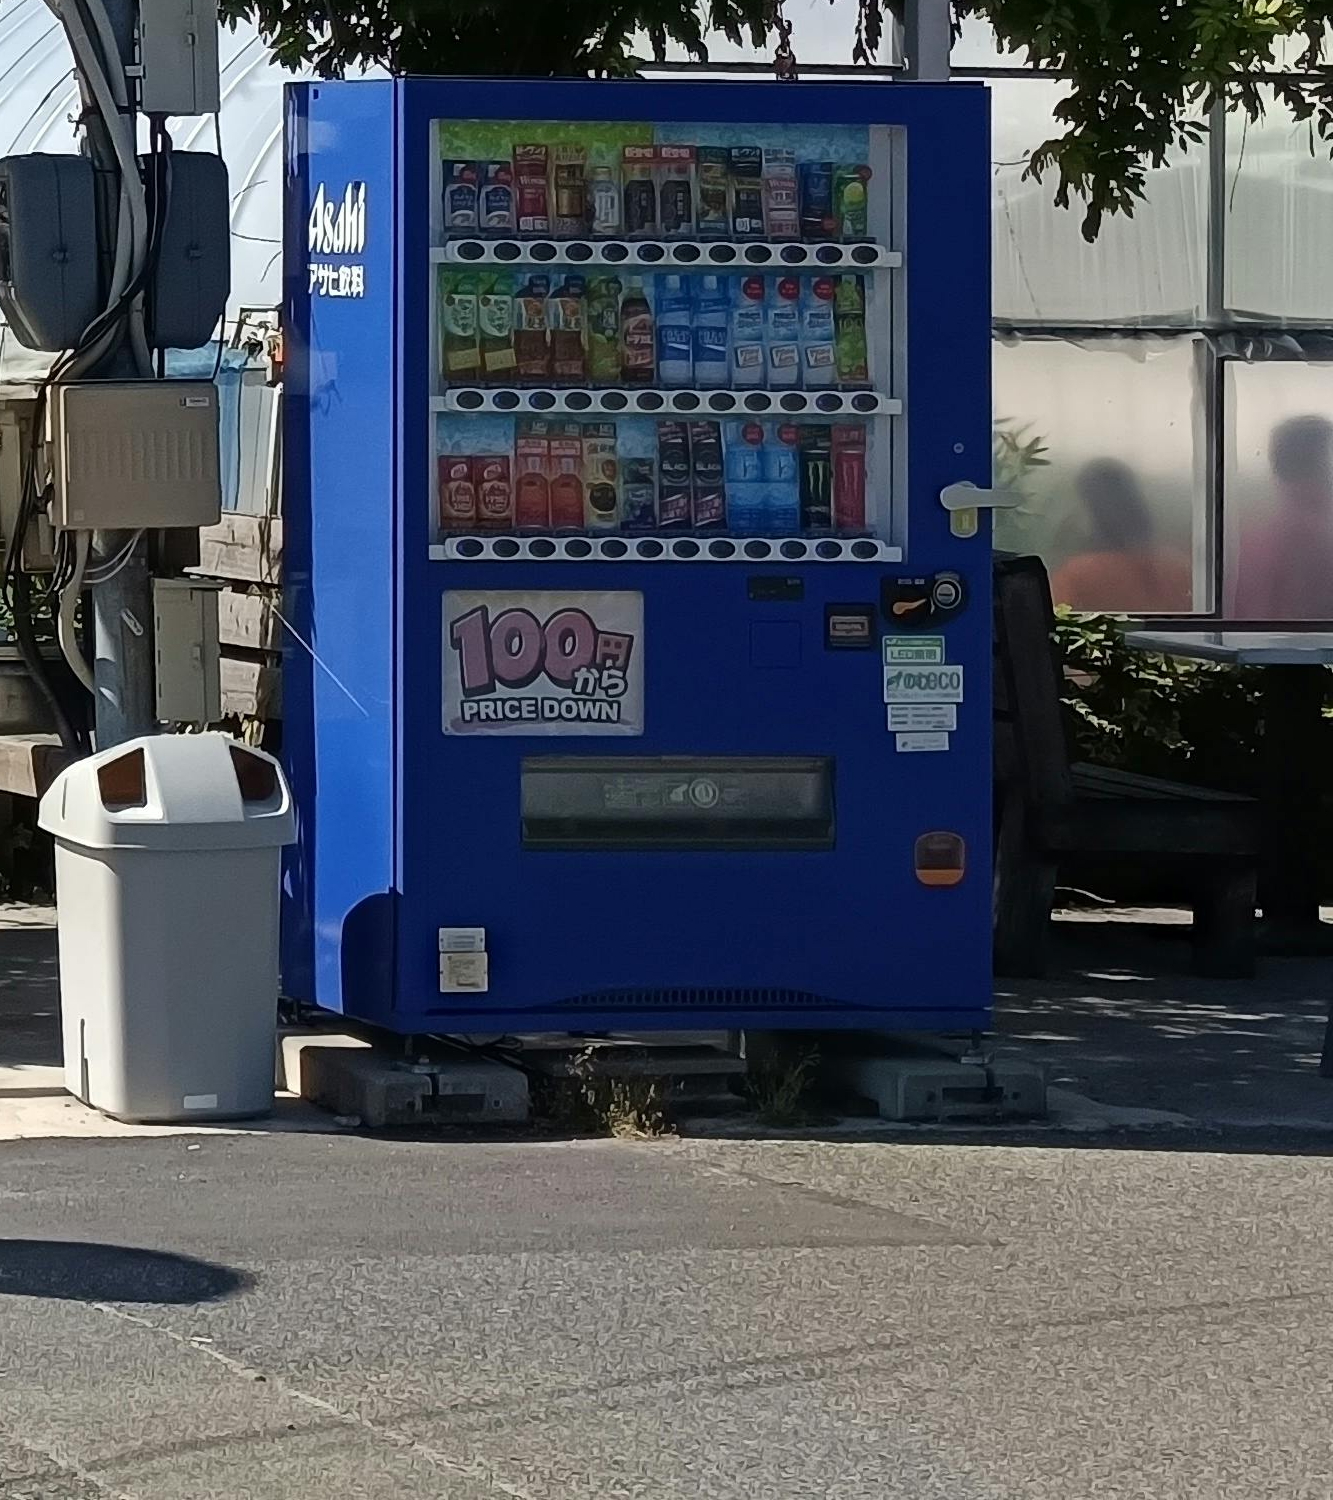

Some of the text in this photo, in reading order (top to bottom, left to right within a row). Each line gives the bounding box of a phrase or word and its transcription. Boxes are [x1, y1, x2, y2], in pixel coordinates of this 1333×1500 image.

[308, 181, 366, 254] Asahi
[307, 263, 364, 298] アサヒ飲料
[462, 699, 621, 723] PRICE DOWN
